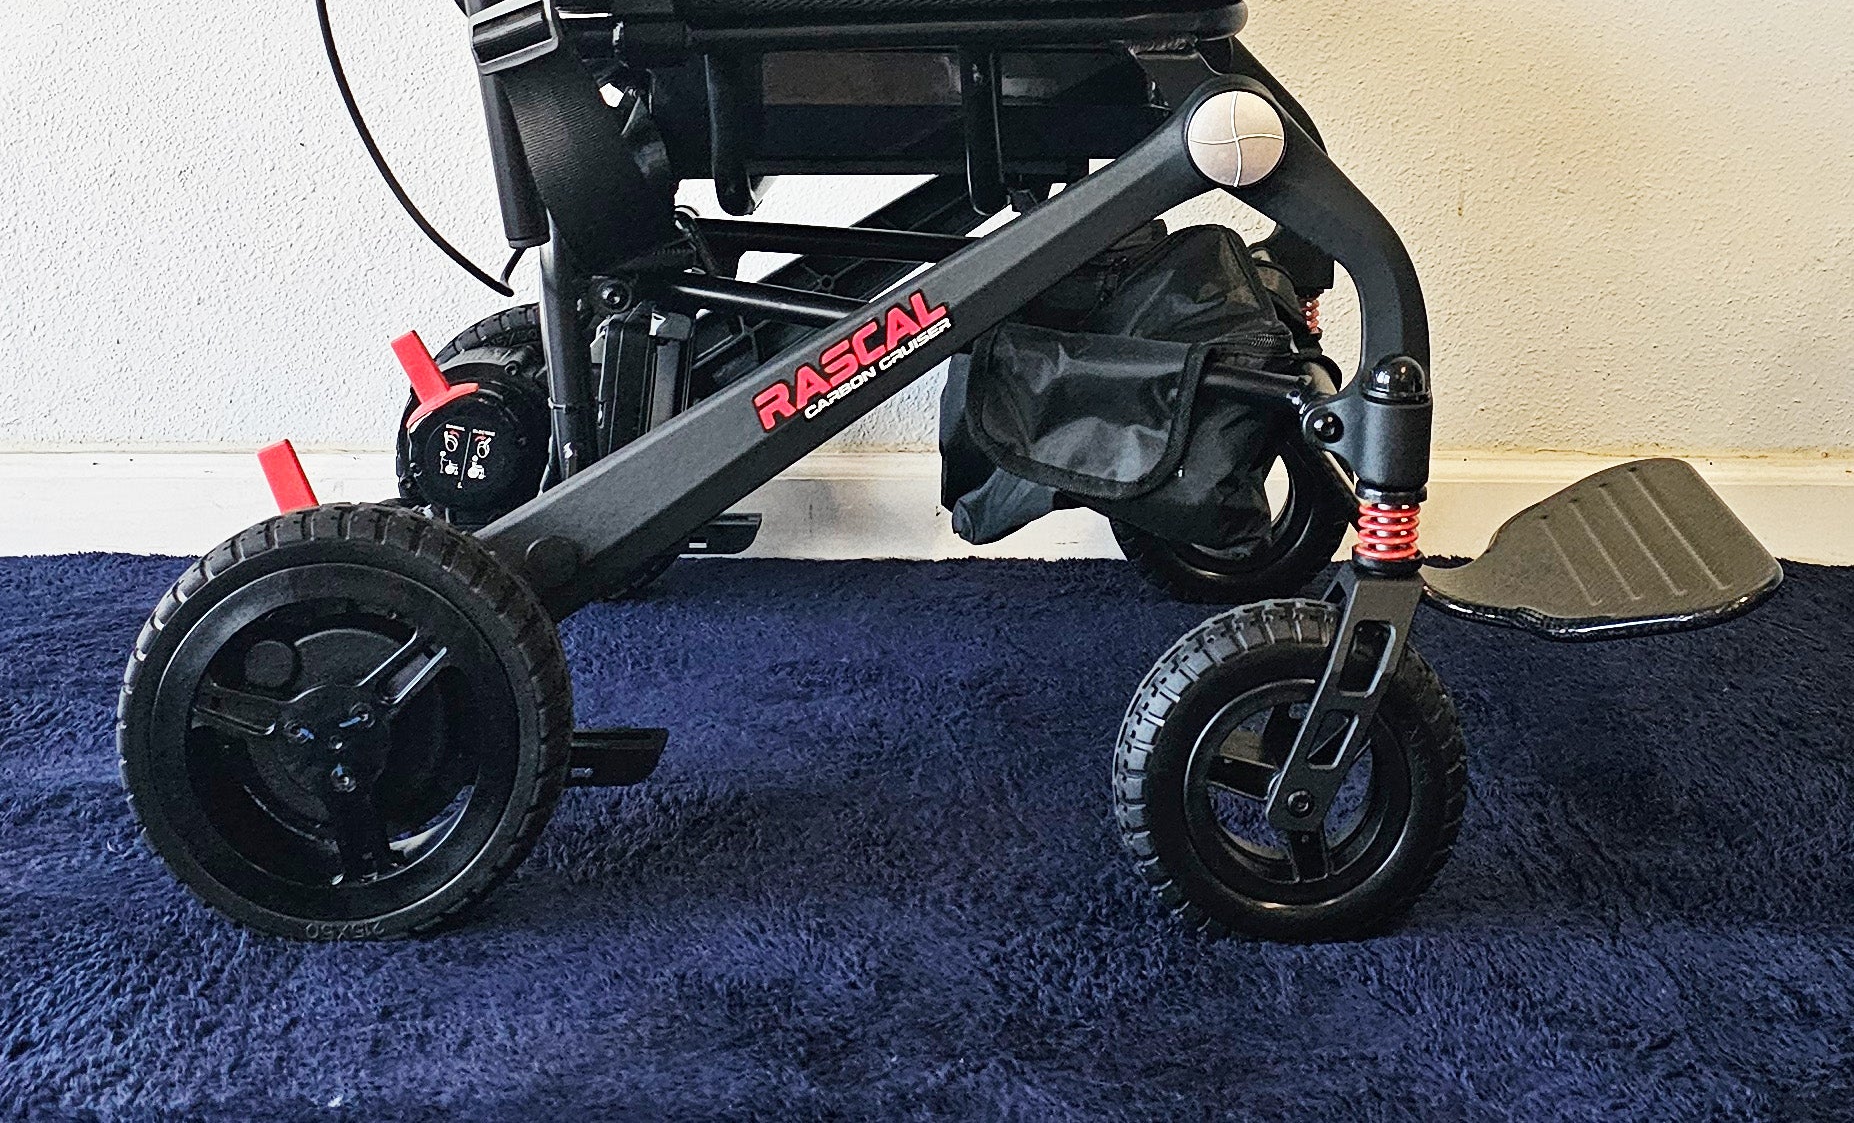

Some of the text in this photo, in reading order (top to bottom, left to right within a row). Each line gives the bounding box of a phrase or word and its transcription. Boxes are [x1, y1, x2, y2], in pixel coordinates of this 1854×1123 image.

[753, 291, 948, 431] RASCAL
[804, 317, 952, 419] CARBON CRUISER
